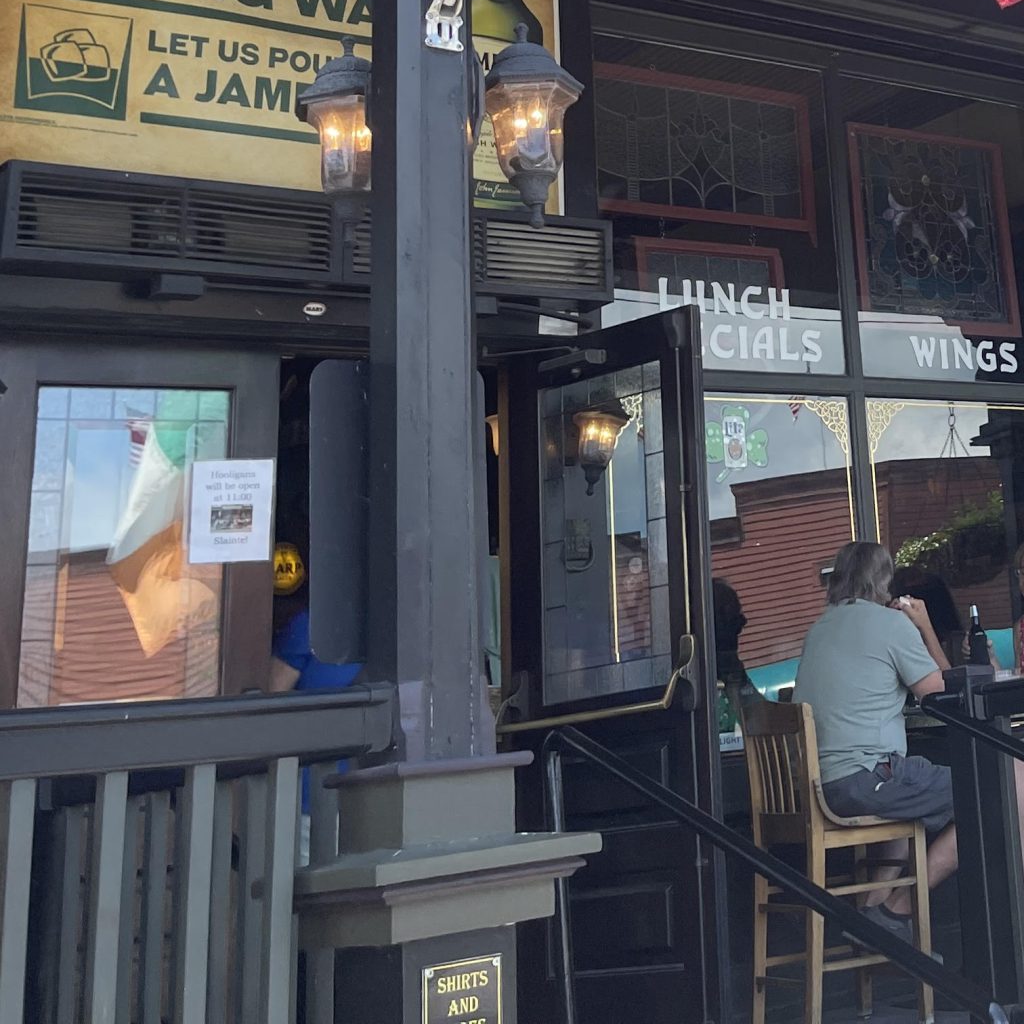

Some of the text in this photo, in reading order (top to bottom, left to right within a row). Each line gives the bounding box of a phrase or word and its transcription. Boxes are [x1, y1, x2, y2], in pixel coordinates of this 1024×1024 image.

[148, 29, 209, 58] LET
[218, 39, 259, 66] US
[143, 63, 180, 99] A
[658, 277, 791, 320] LUNCH
[700, 322, 822, 362] CIALS
[909, 335, 1018, 373] WINGS
[437, 970, 489, 994] SHIRTS
[447, 996, 479, 1017] AND
